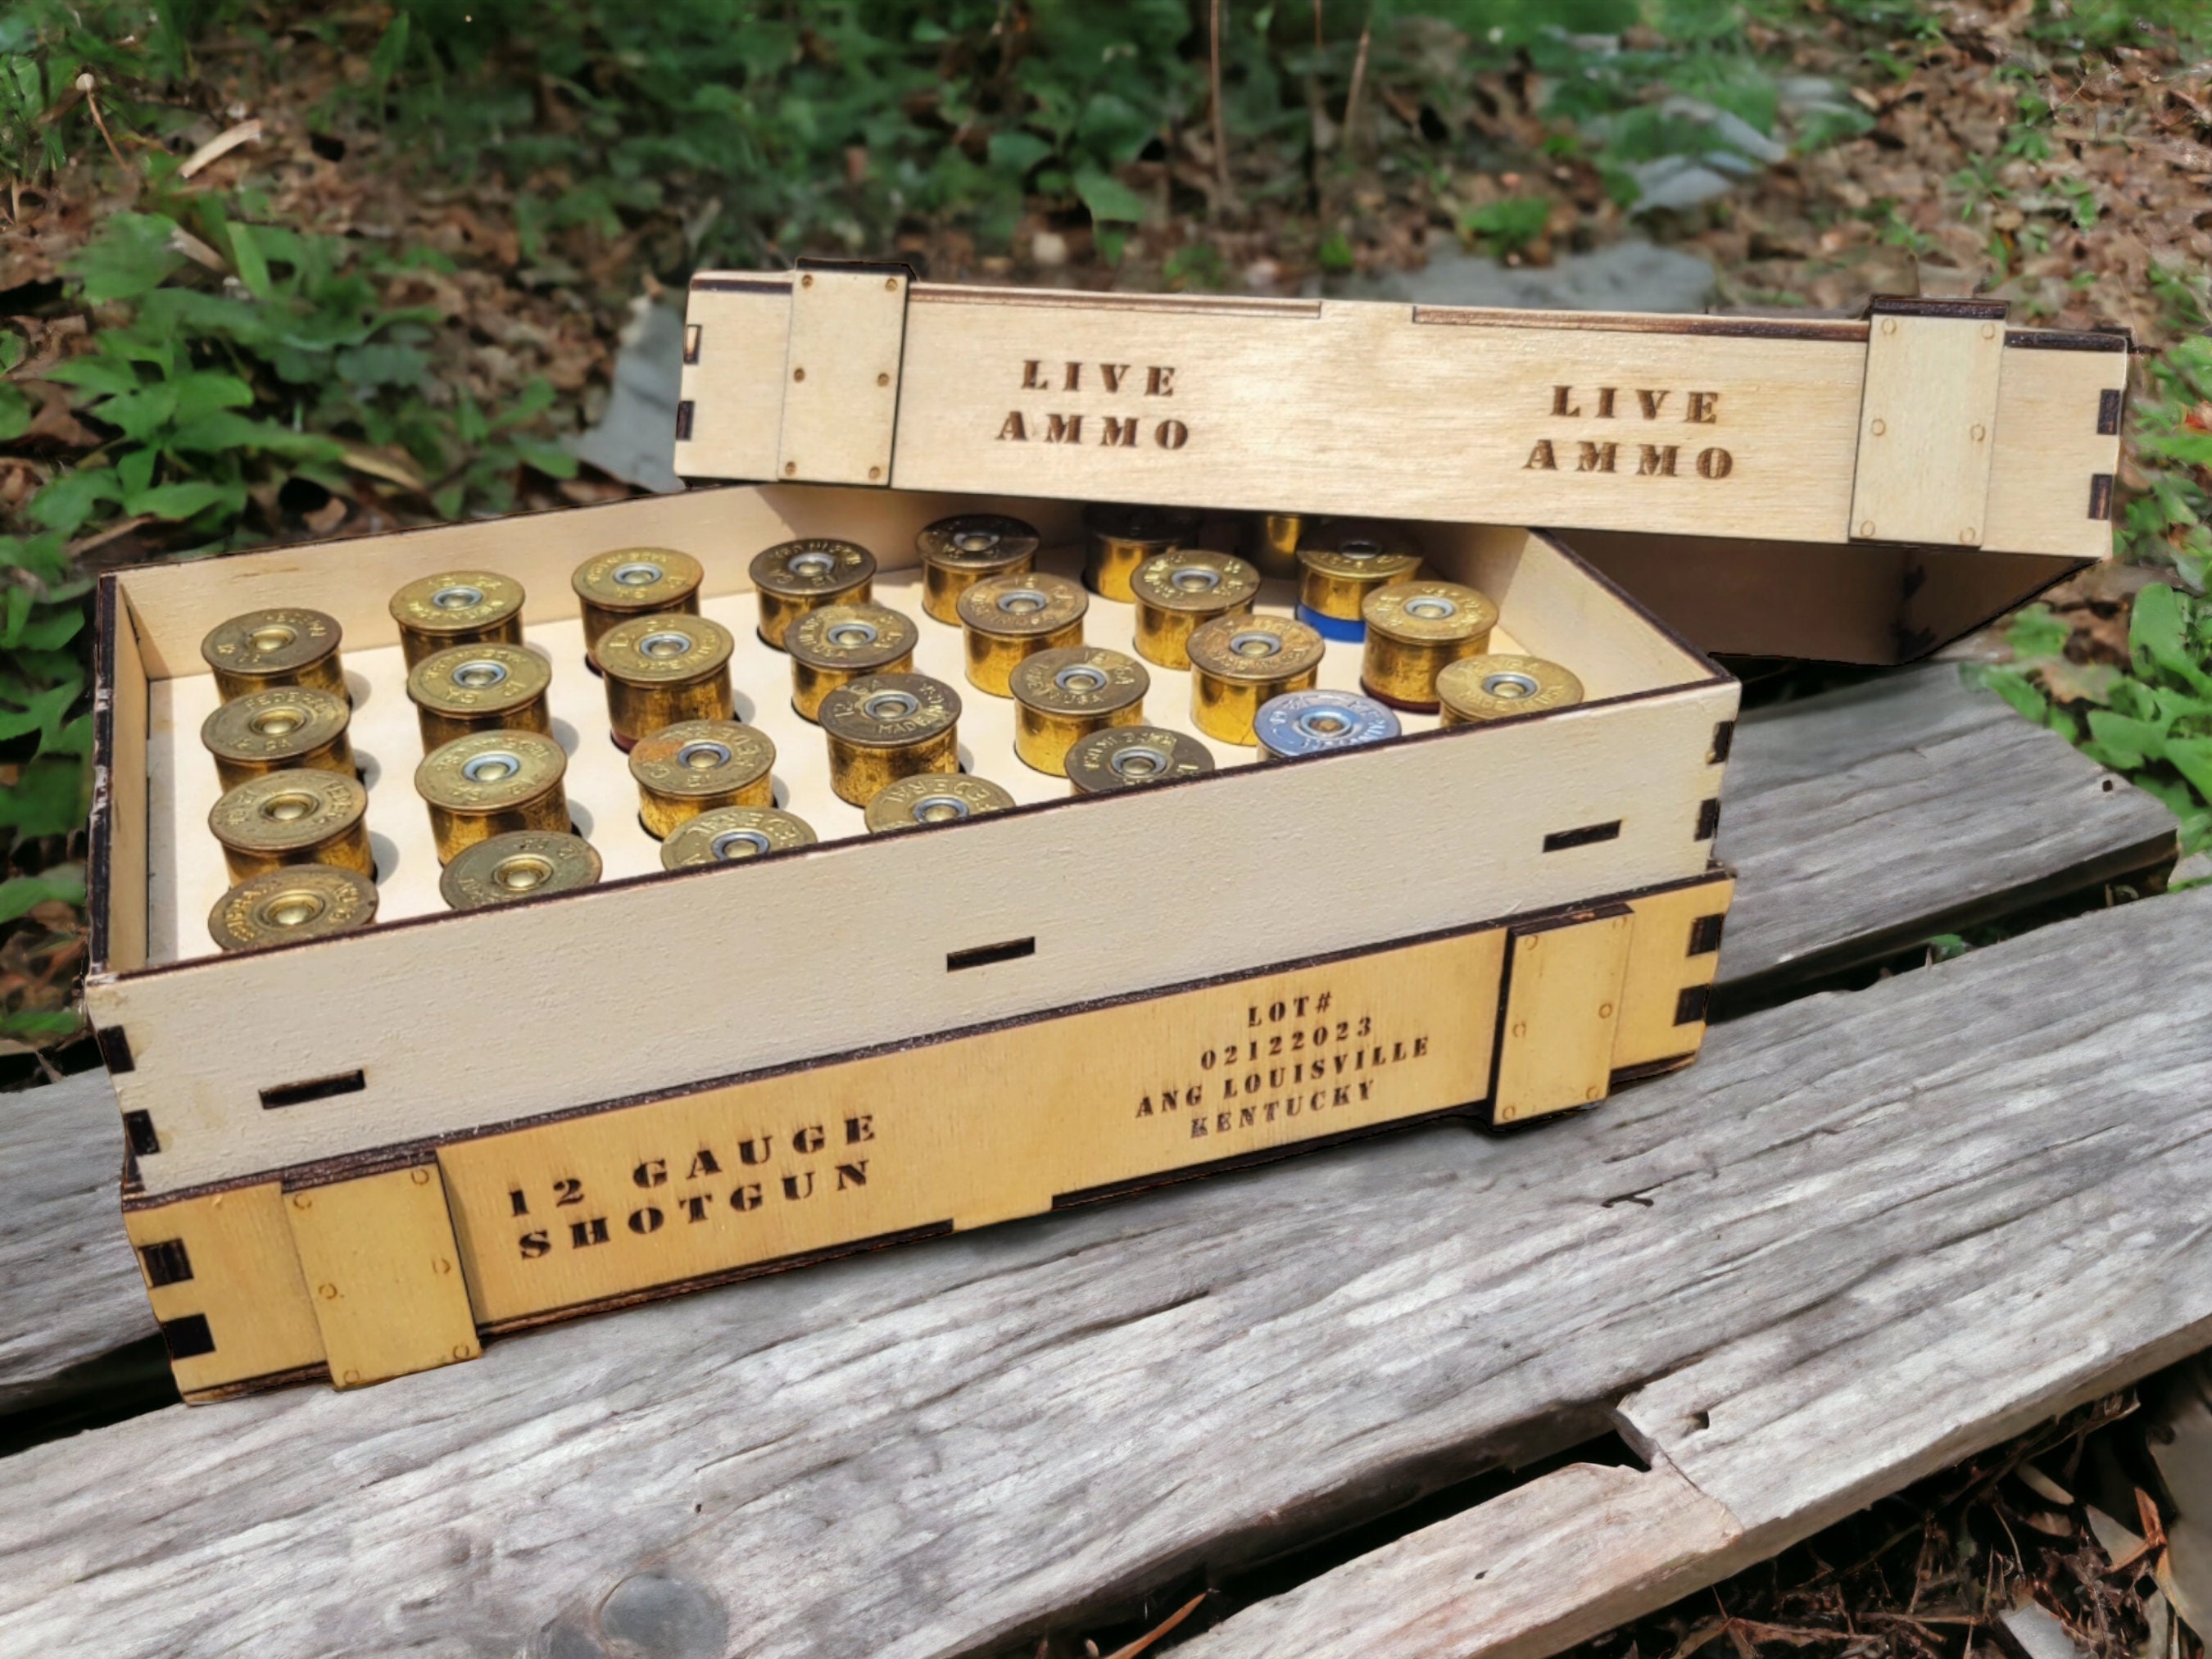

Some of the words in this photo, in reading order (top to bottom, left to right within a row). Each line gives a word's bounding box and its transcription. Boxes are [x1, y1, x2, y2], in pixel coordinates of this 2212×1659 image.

[1021, 360, 1176, 397] LIVE
[1551, 385, 1720, 425] LIVE
[995, 410, 1190, 450] AMMO
[1522, 439, 1734, 480] AMMO
[1248, 991, 1332, 1027] LOT#
[1201, 1017, 1371, 1070] 02122023
[1135, 1084, 1203, 1119] ANG
[1223, 1036, 1429, 1099] LOUISVILLE
[1190, 1080, 1375, 1139] KENTUCKY
[508, 1178, 585, 1217] 12
[632, 1114, 877, 1189] GAUGE
[518, 1159, 870, 1260] SHOTGUN
